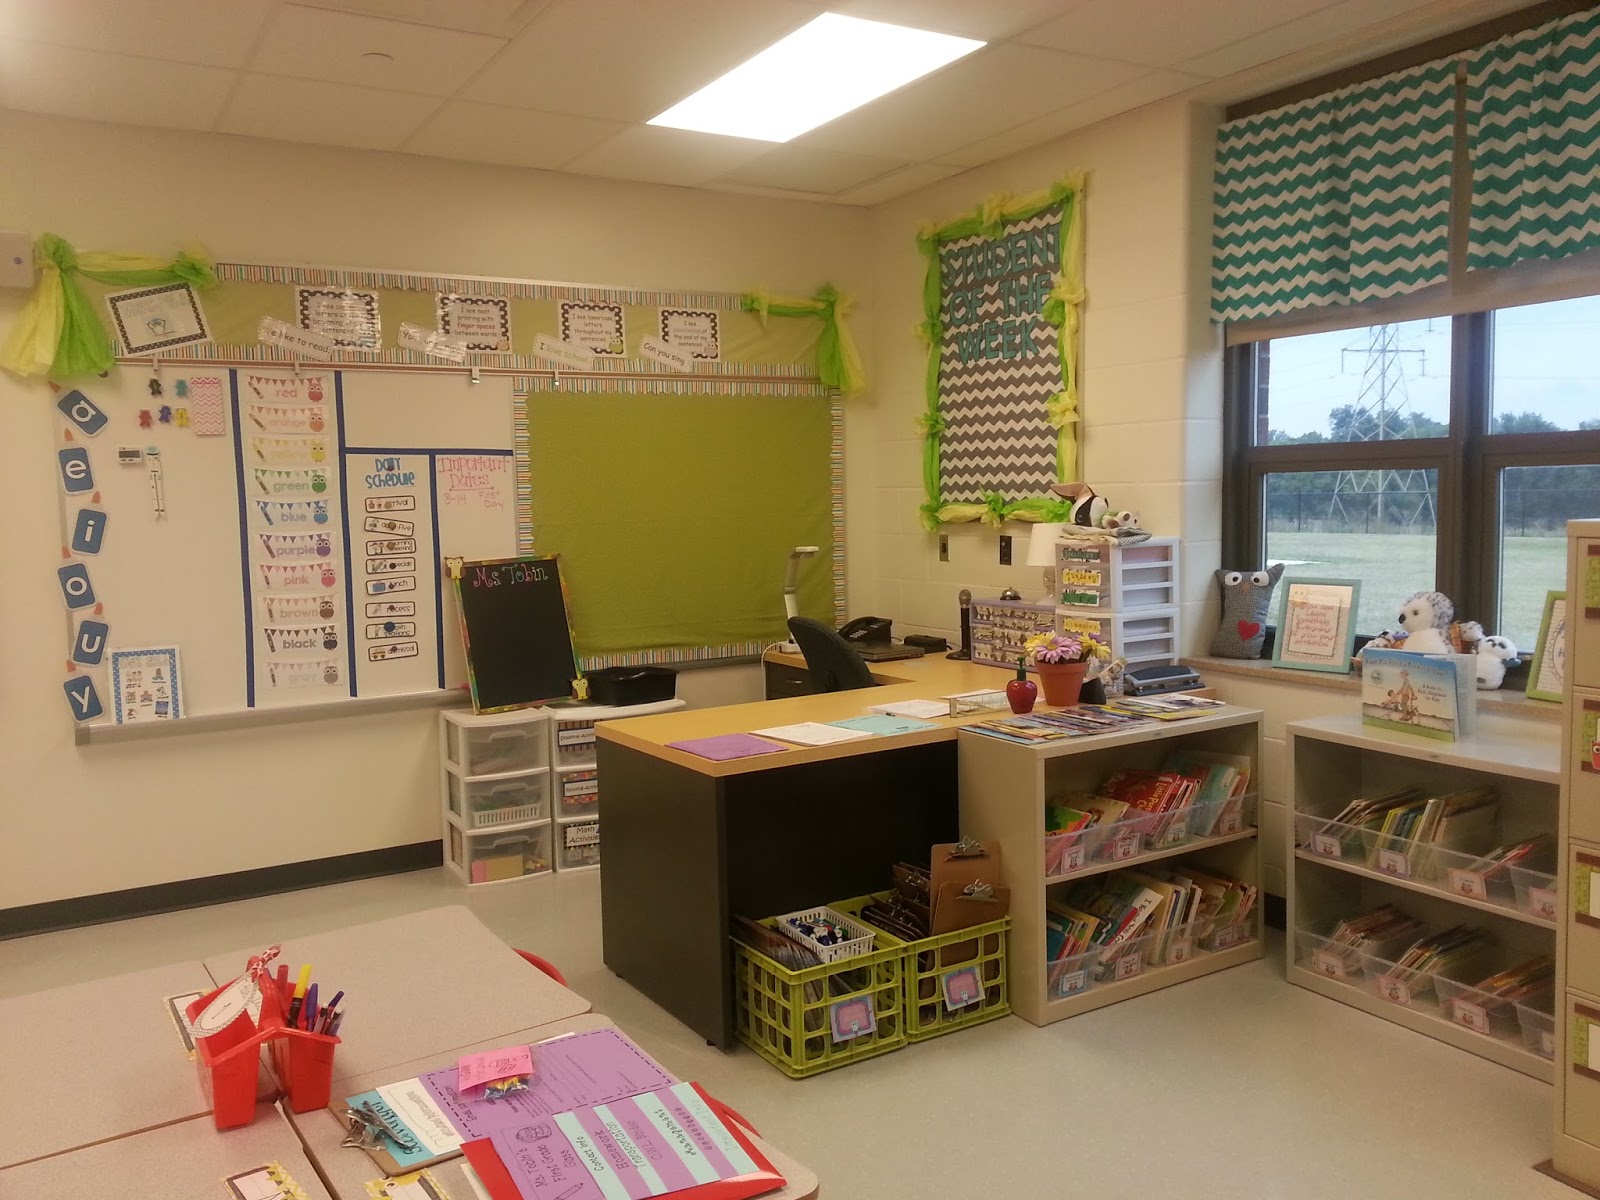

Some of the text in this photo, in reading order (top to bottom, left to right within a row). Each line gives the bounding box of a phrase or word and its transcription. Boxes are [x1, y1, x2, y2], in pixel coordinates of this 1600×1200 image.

[941, 223, 1061, 286] STUDENT
[950, 273, 1052, 325] OF THE
[297, 337, 306, 346] to
[540, 342, 545, 351] I
[956, 316, 1040, 365] WEEK
[643, 342, 685, 366] Can you sing
[275, 389, 298, 398] red
[71, 399, 97, 423] a
[65, 459, 87, 479] e
[437, 456, 510, 473] Important
[272, 482, 310, 493] green
[450, 472, 490, 488] Dates
[444, 492, 467, 505] 8-14
[483, 500, 505, 512] Day
[280, 512, 307, 522] blue
[84, 519, 95, 542] i
[398, 523, 412, 532] five
[276, 545, 316, 557] purple
[283, 574, 310, 587] pink
[501, 563, 549, 585] Tobin
[65, 576, 88, 596] o
[279, 608, 318, 619] brown
[81, 633, 101, 654] u
[282, 638, 317, 650] black
[71, 685, 91, 714] y
[569, 834, 599, 844] Activitie
[576, 826, 595, 835] Math
[593, 1128, 629, 1170] Homework
[605, 1119, 646, 1169] Transportation
[515, 1146, 548, 1188] Ms. Tobin's
[536, 1141, 567, 1182] First Grade
[561, 1148, 577, 1169] Class
[583, 1147, 605, 1171] Contact
